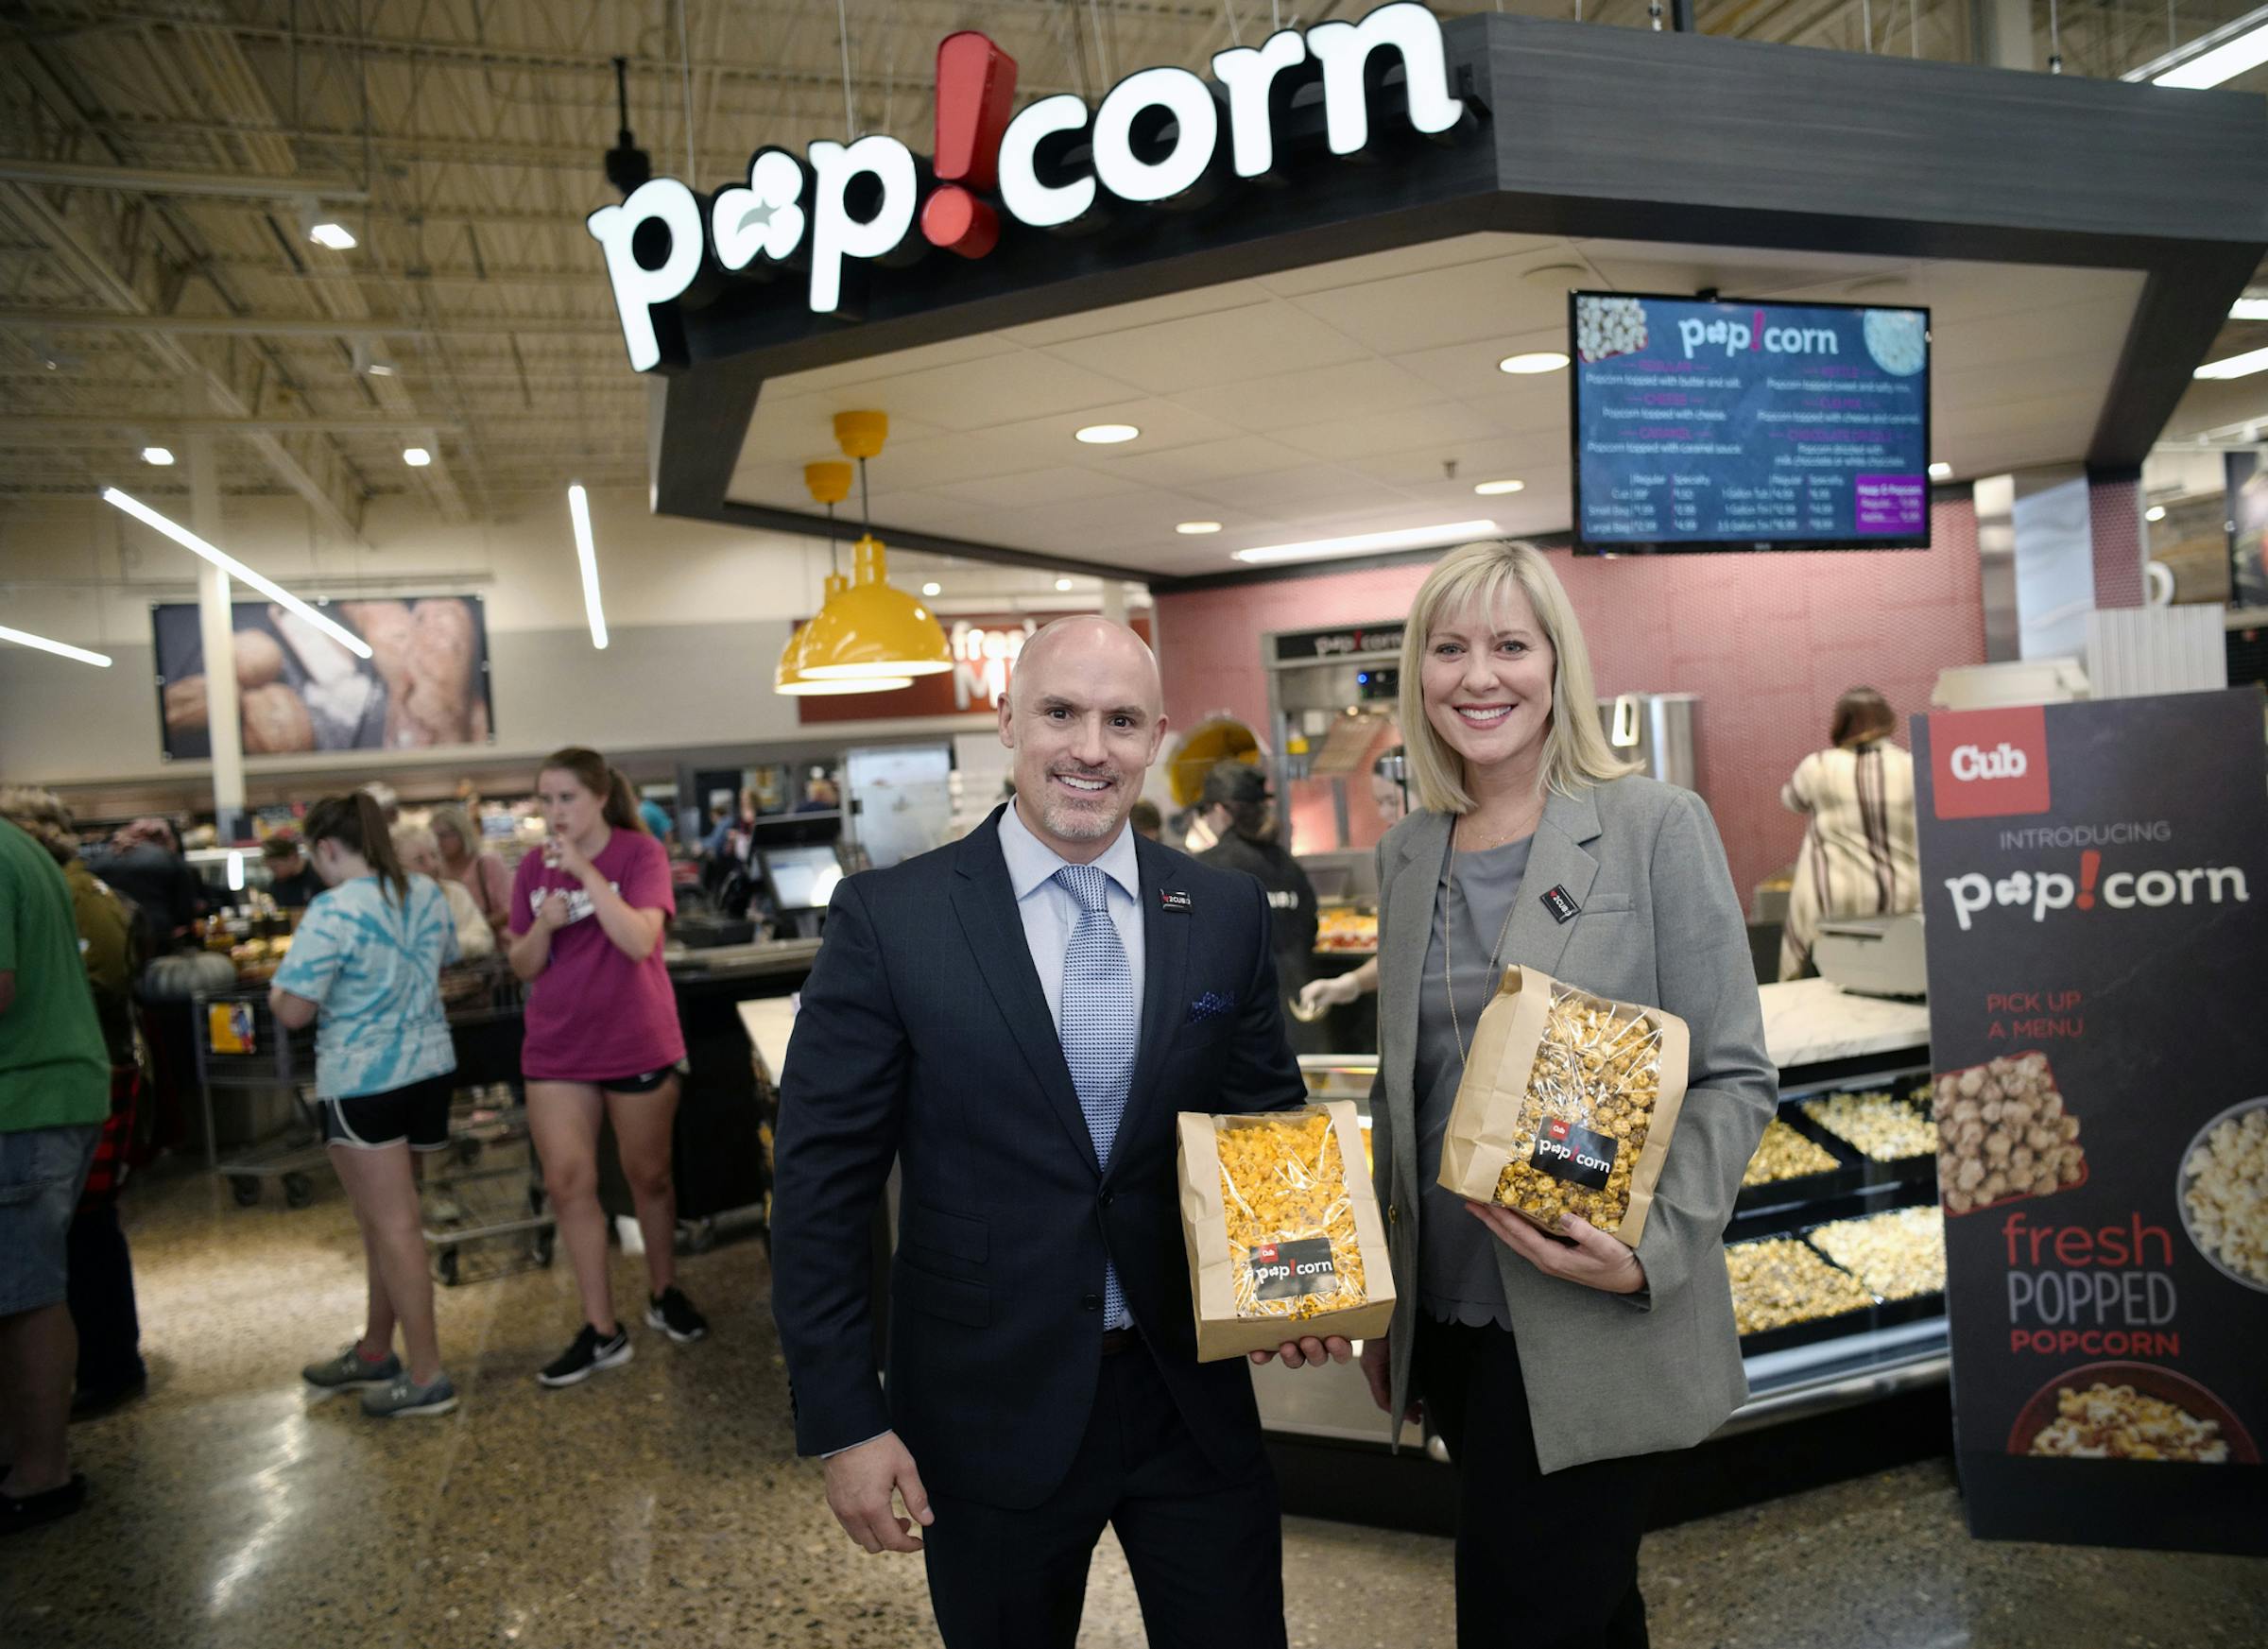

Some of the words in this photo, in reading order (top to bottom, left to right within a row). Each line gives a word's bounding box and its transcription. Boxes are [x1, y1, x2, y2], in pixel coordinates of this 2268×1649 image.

[1950, 743, 2028, 782] Cub
[2000, 820, 2173, 850] INTRODUCING
[1987, 992, 2041, 1014] PICK
[2047, 989, 2084, 1011] UP
[1987, 1022, 2008, 1040] A
[2014, 1017, 2085, 1039] MENU
[2002, 1211, 2174, 1267] fresh
[2007, 1271, 2177, 1326] POPPED
[2010, 1331, 2179, 1357] POPCORN
